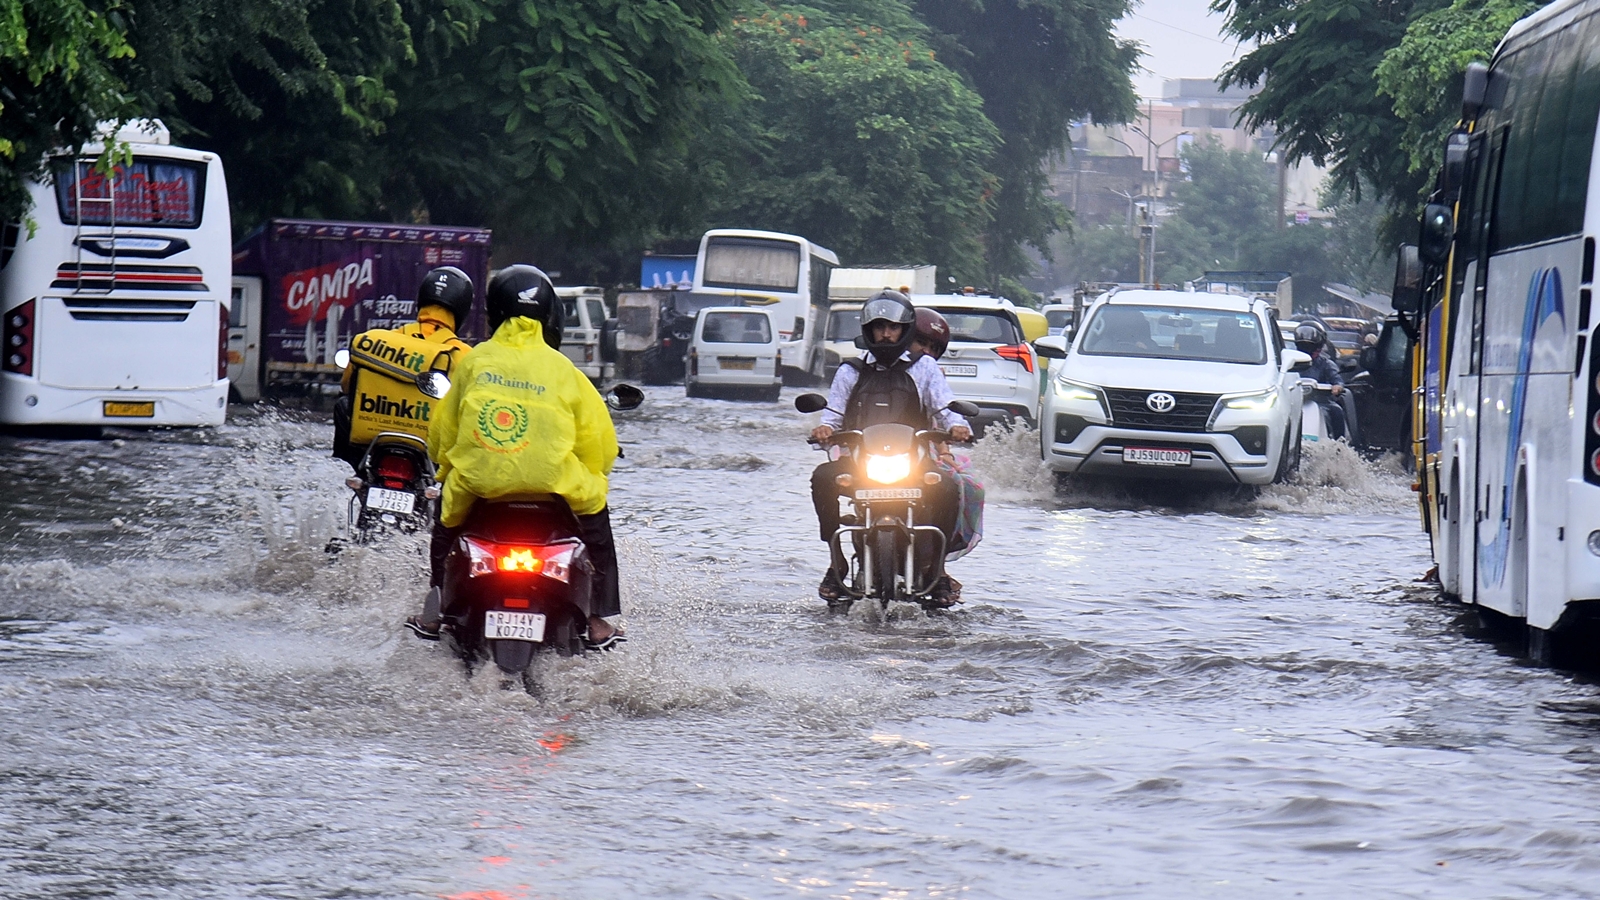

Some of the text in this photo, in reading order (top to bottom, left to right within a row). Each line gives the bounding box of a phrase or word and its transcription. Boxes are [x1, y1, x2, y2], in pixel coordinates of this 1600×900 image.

[287, 258, 373, 310] CAMPA
[357, 335, 425, 372] blinkit
[493, 374, 546, 395] Raintop
[360, 393, 430, 421] blinkit
[358, 415, 377, 423] India's
[379, 417, 393, 425] Last
[393, 419, 413, 428] Minute
[1130, 450, 1189, 462] RJ59UC0027
[379, 499, 408, 511] J7457
[496, 625, 533, 639] K0720
